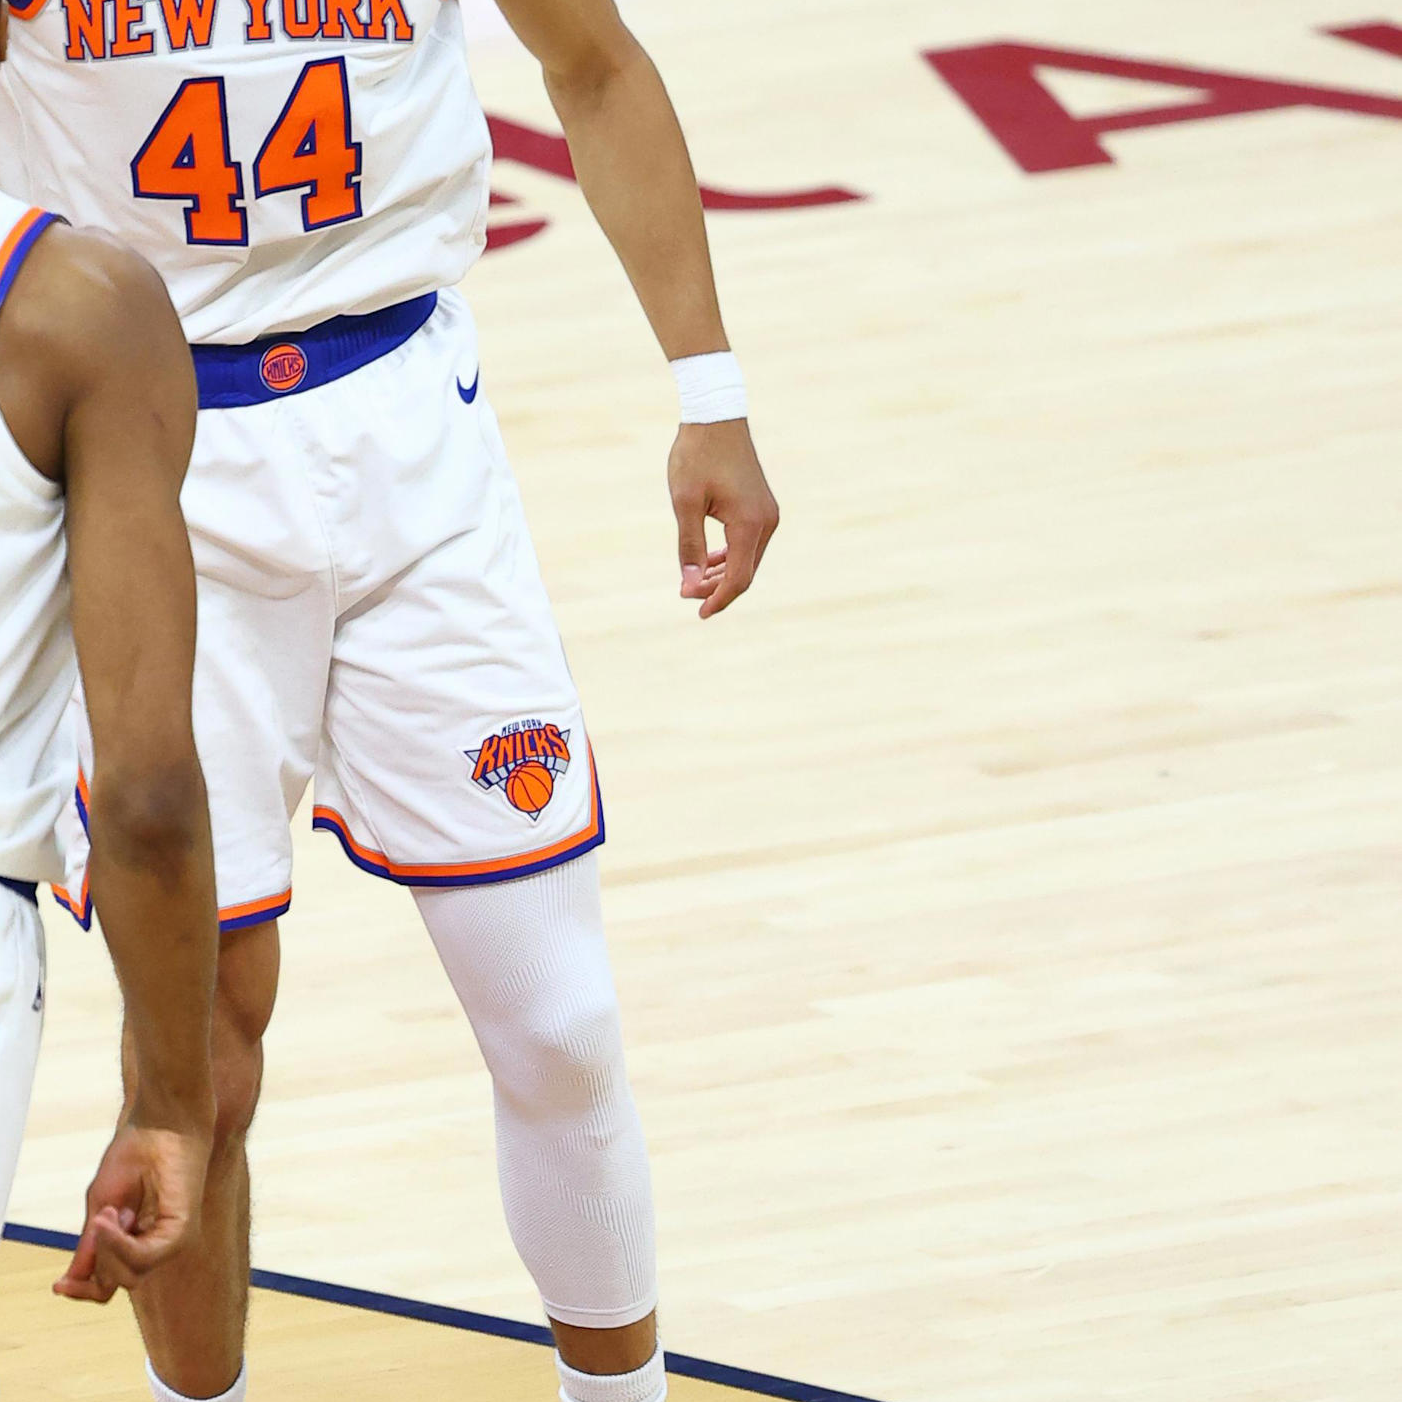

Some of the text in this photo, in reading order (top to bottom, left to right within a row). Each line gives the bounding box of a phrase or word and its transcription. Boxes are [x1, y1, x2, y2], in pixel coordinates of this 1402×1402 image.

[130, 55, 363, 246] 44
[471, 722, 571, 784] KNICKS
[501, 721, 520, 736] NEW
